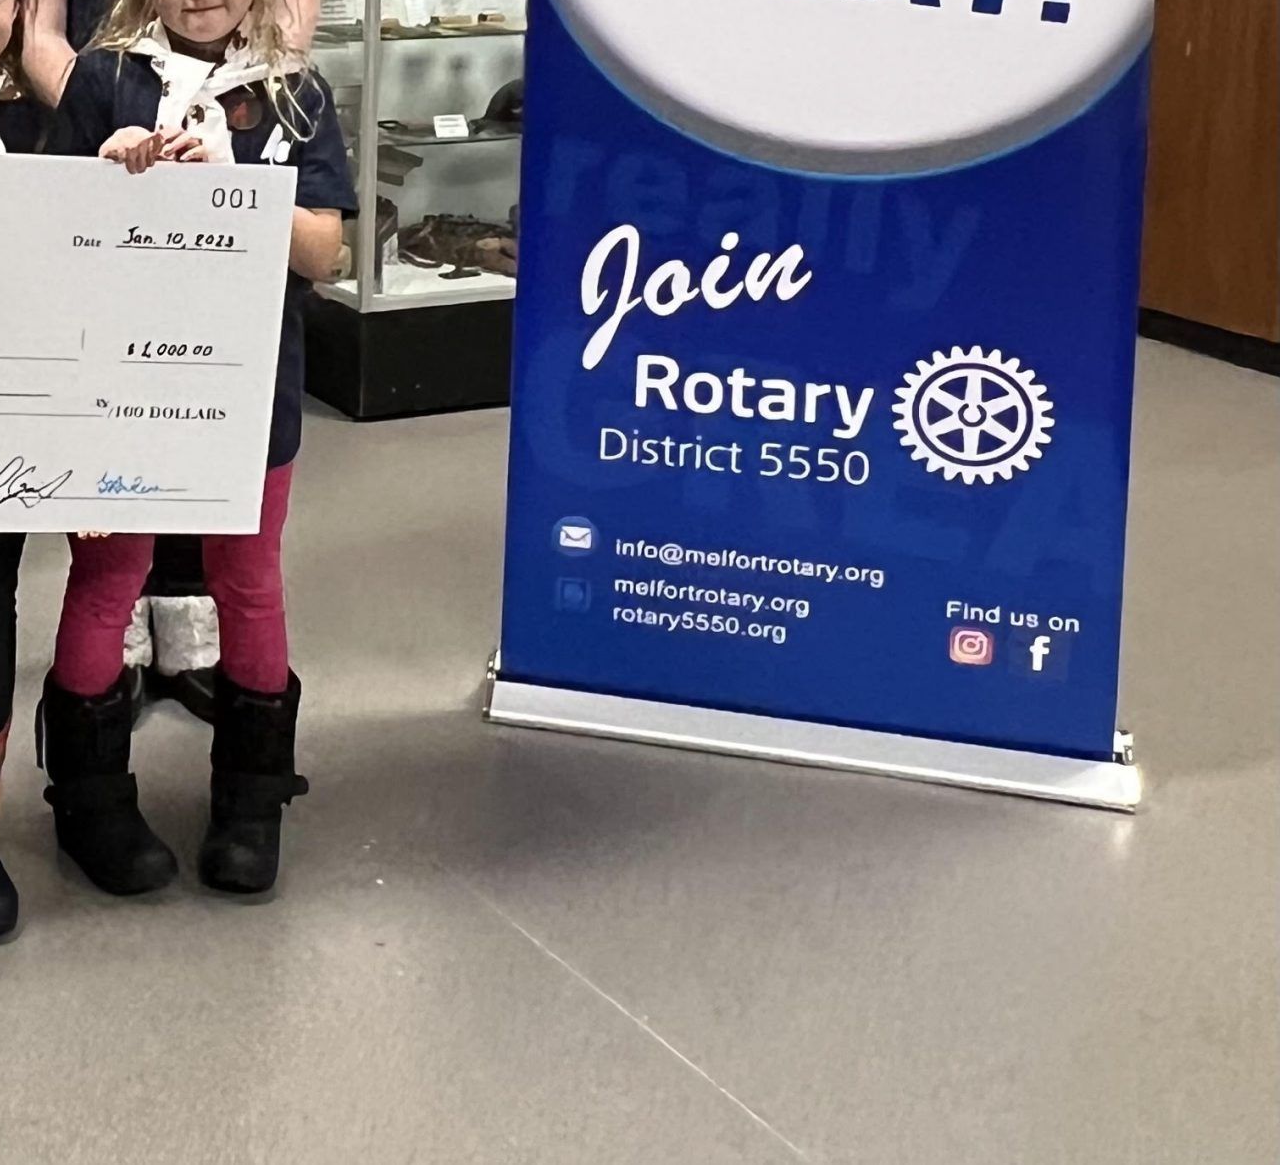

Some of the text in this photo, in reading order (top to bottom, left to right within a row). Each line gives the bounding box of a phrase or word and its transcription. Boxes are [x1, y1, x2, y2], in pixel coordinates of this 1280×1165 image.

[211, 187, 258, 209] 001
[122, 226, 157, 246] Jan.
[194, 233, 235, 248] 2023
[581, 224, 813, 370] Join
[149, 406, 227, 421] DOLLARS
[633, 354, 875, 439] Rotary
[599, 427, 870, 486] District 5550
[615, 538, 885, 588] info@melfortrotary.org
[614, 577, 810, 619] melfortrotary.org
[946, 600, 1080, 633] Find us on
[612, 606, 787, 644] rotary5550.org
